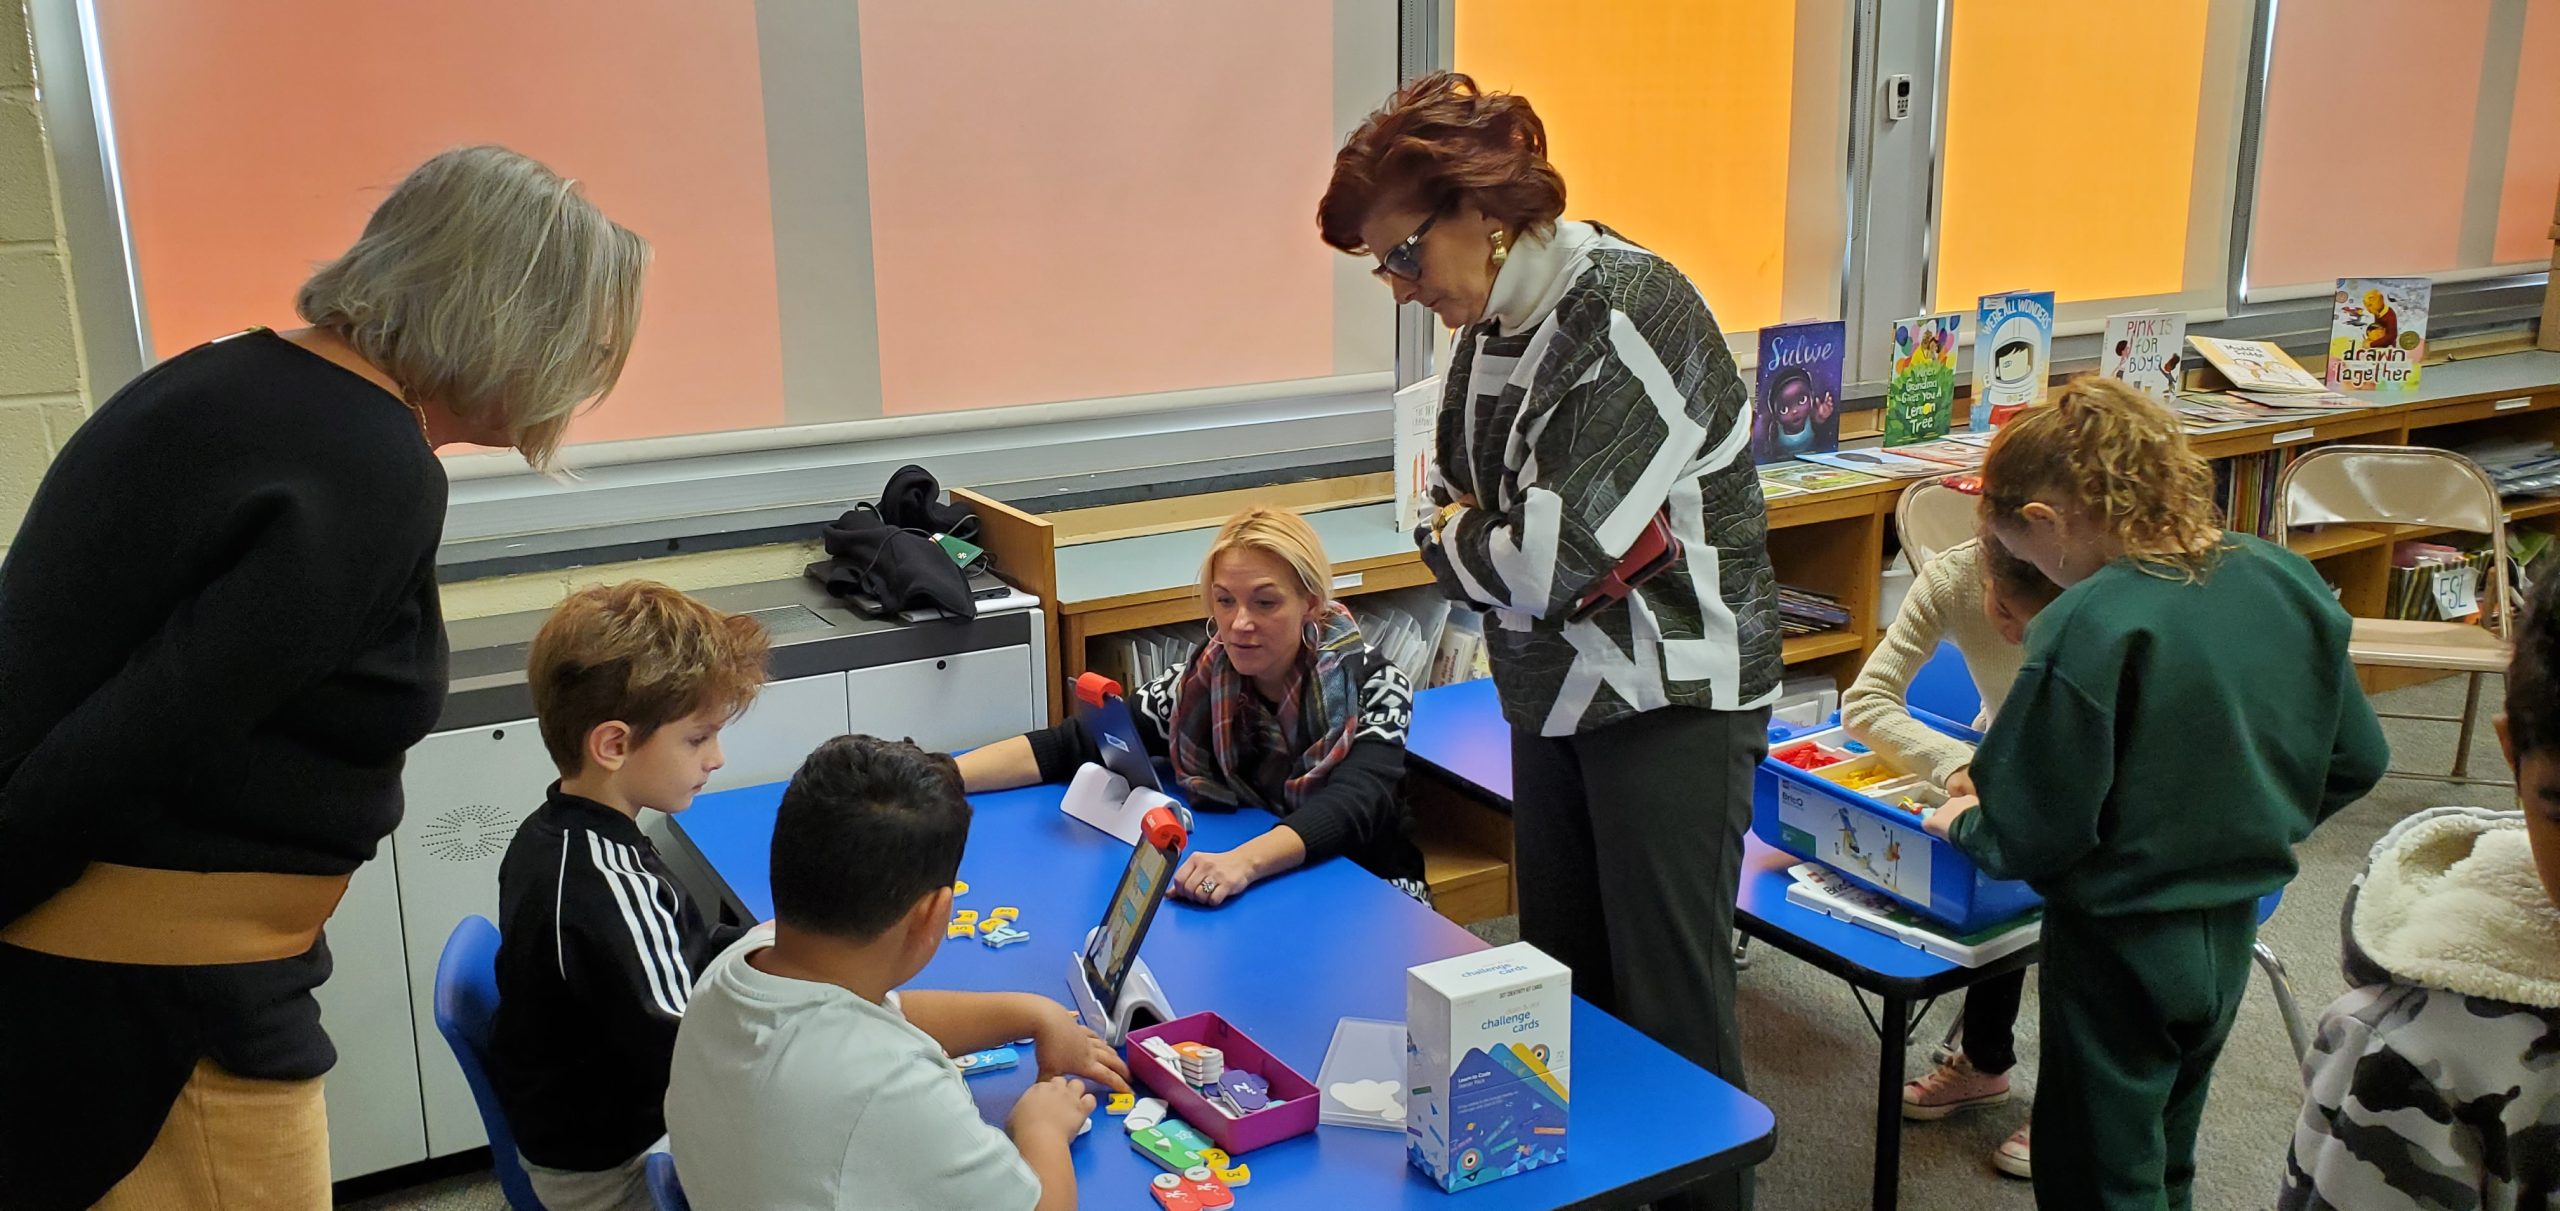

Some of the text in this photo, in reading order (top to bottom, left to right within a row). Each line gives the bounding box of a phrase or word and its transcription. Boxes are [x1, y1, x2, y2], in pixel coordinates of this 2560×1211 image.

[2017, 298, 2052, 329] WONDERS
[2126, 319, 2174, 338] PINK IS
[1767, 335, 1834, 371] Sulwe
[2343, 339, 2406, 362] drawn
[2128, 354, 2162, 374] BOYS
[1905, 376, 1937, 392] Grandma
[1901, 391, 1920, 403] Gives
[1922, 391, 1936, 402] You
[1905, 402, 1936, 420] Lemon
[1909, 416, 1934, 434] Tree
[1782, 792, 1803, 807] BricQ
[1461, 963, 1512, 978] challenge
[1499, 965, 1528, 975] cards
[1481, 1011, 1531, 1030] challenge
[1512, 1019, 1540, 1034] cards
